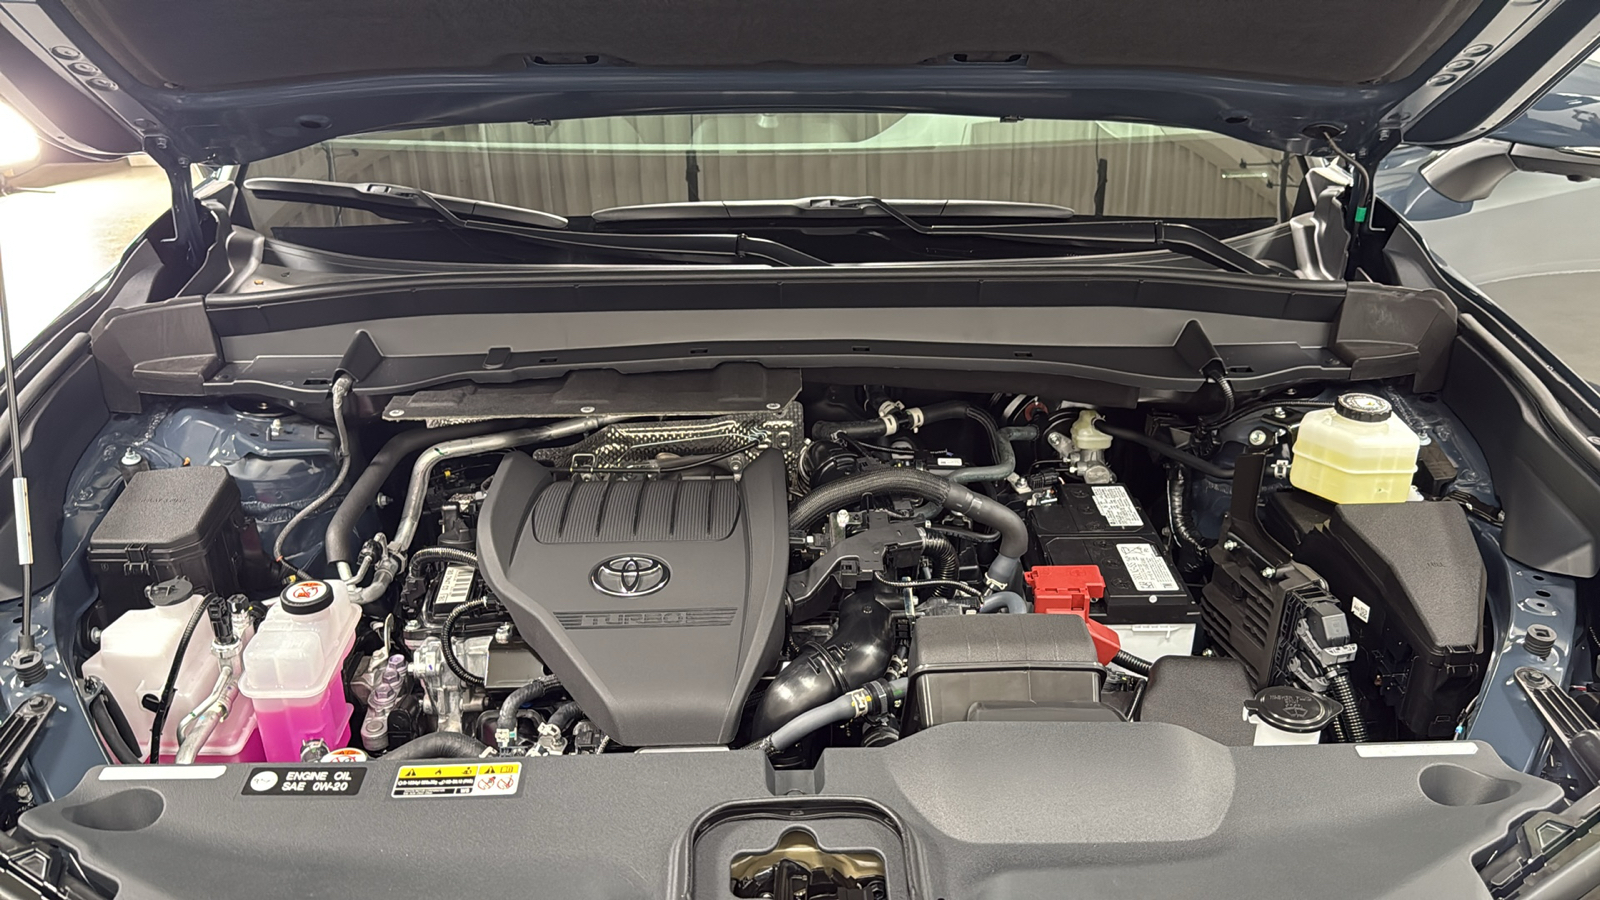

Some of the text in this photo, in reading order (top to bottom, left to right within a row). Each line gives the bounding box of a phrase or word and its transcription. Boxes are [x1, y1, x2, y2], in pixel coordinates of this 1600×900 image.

[584, 613, 683, 626] TURBO
[285, 771, 352, 781] ENGINE OIL
[281, 781, 348, 791] SAE 0W-20
